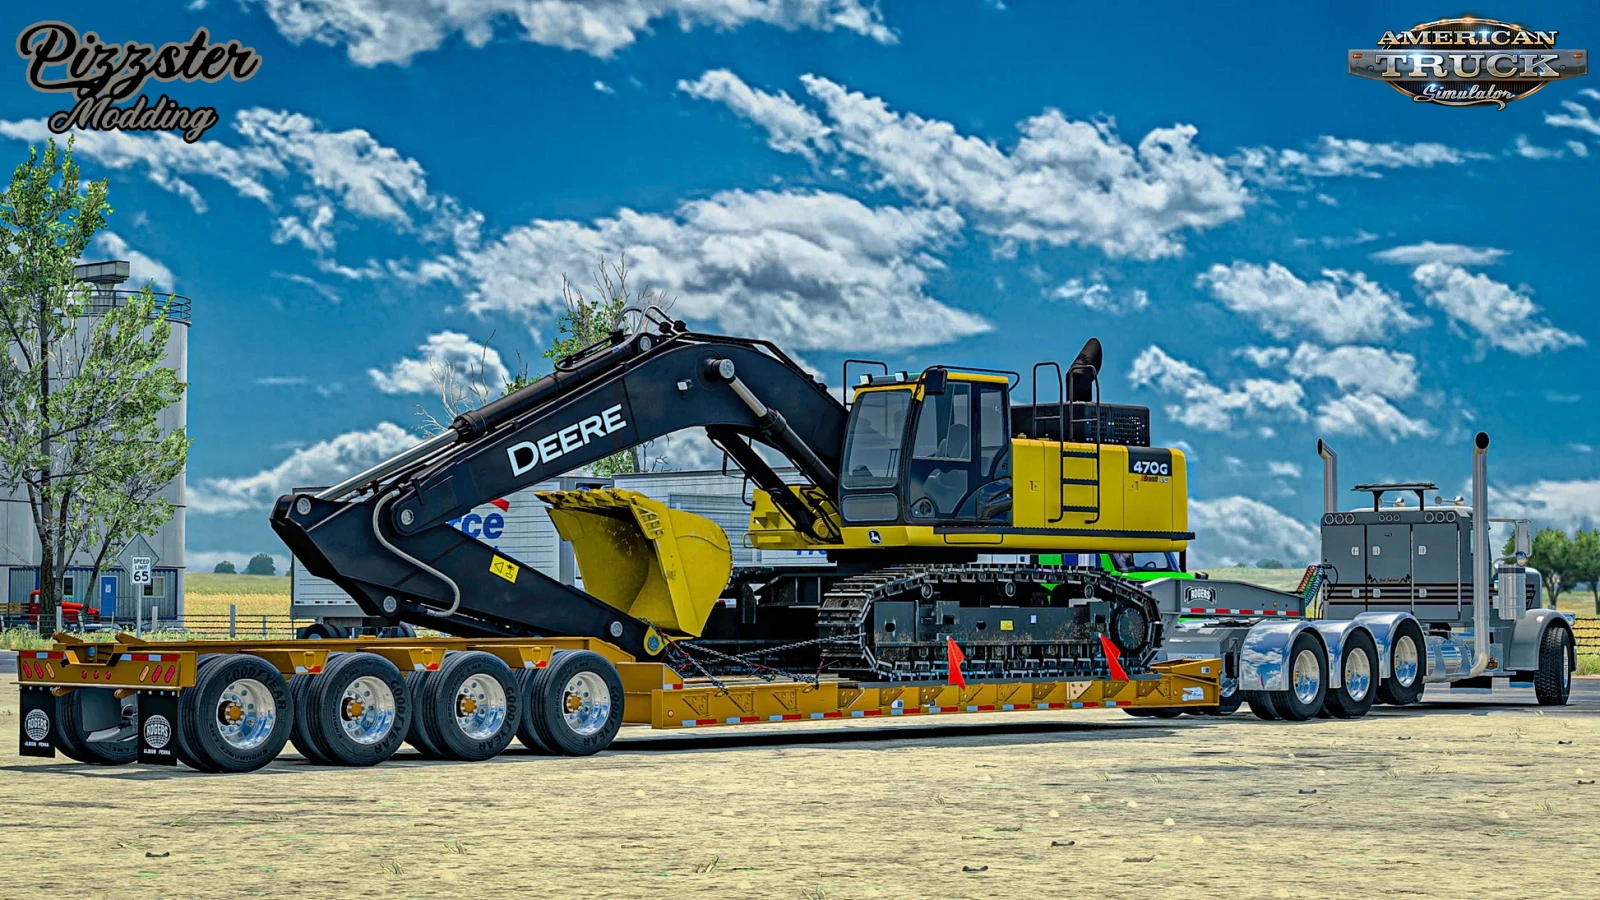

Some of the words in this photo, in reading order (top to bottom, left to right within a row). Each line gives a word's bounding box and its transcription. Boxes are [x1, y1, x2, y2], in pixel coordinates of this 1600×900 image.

[506, 403, 627, 477] DEERE
[1133, 461, 1168, 475] 470G
[133, 571, 149, 582] 65
[1190, 588, 1212, 600] ROGERS
[27, 717, 48, 731] ROGERS
[146, 723, 169, 737] ROGERS
